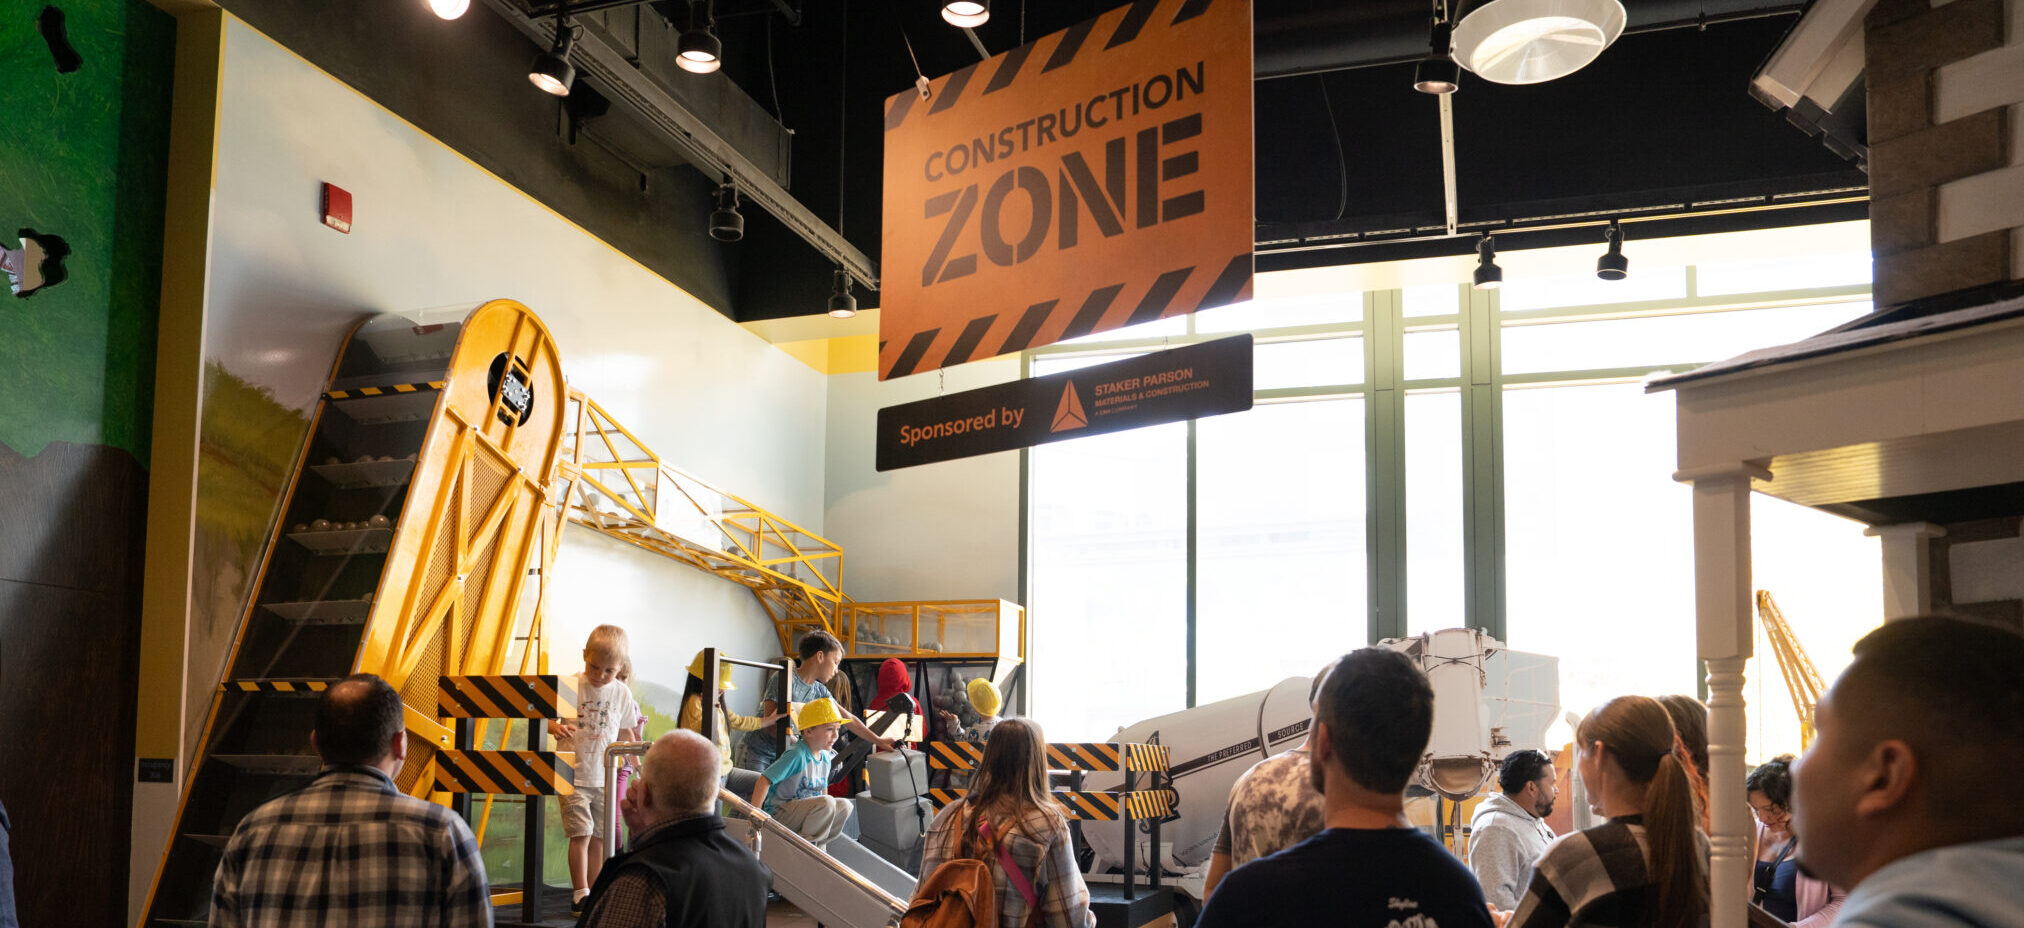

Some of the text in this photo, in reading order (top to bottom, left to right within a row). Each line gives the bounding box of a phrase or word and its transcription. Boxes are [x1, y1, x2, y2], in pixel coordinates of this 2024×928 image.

[924, 61, 1205, 183] CONSTRUCTION
[922, 112, 1205, 287] ZONE
[1094, 380, 1209, 407] MATERIALS & CONSTRUCTION
[1095, 368, 1193, 397] STAKER PARSON
[900, 406, 1025, 447] Sponsored by
[1207, 722, 1304, 763] THE PREFERRED SOURCE
